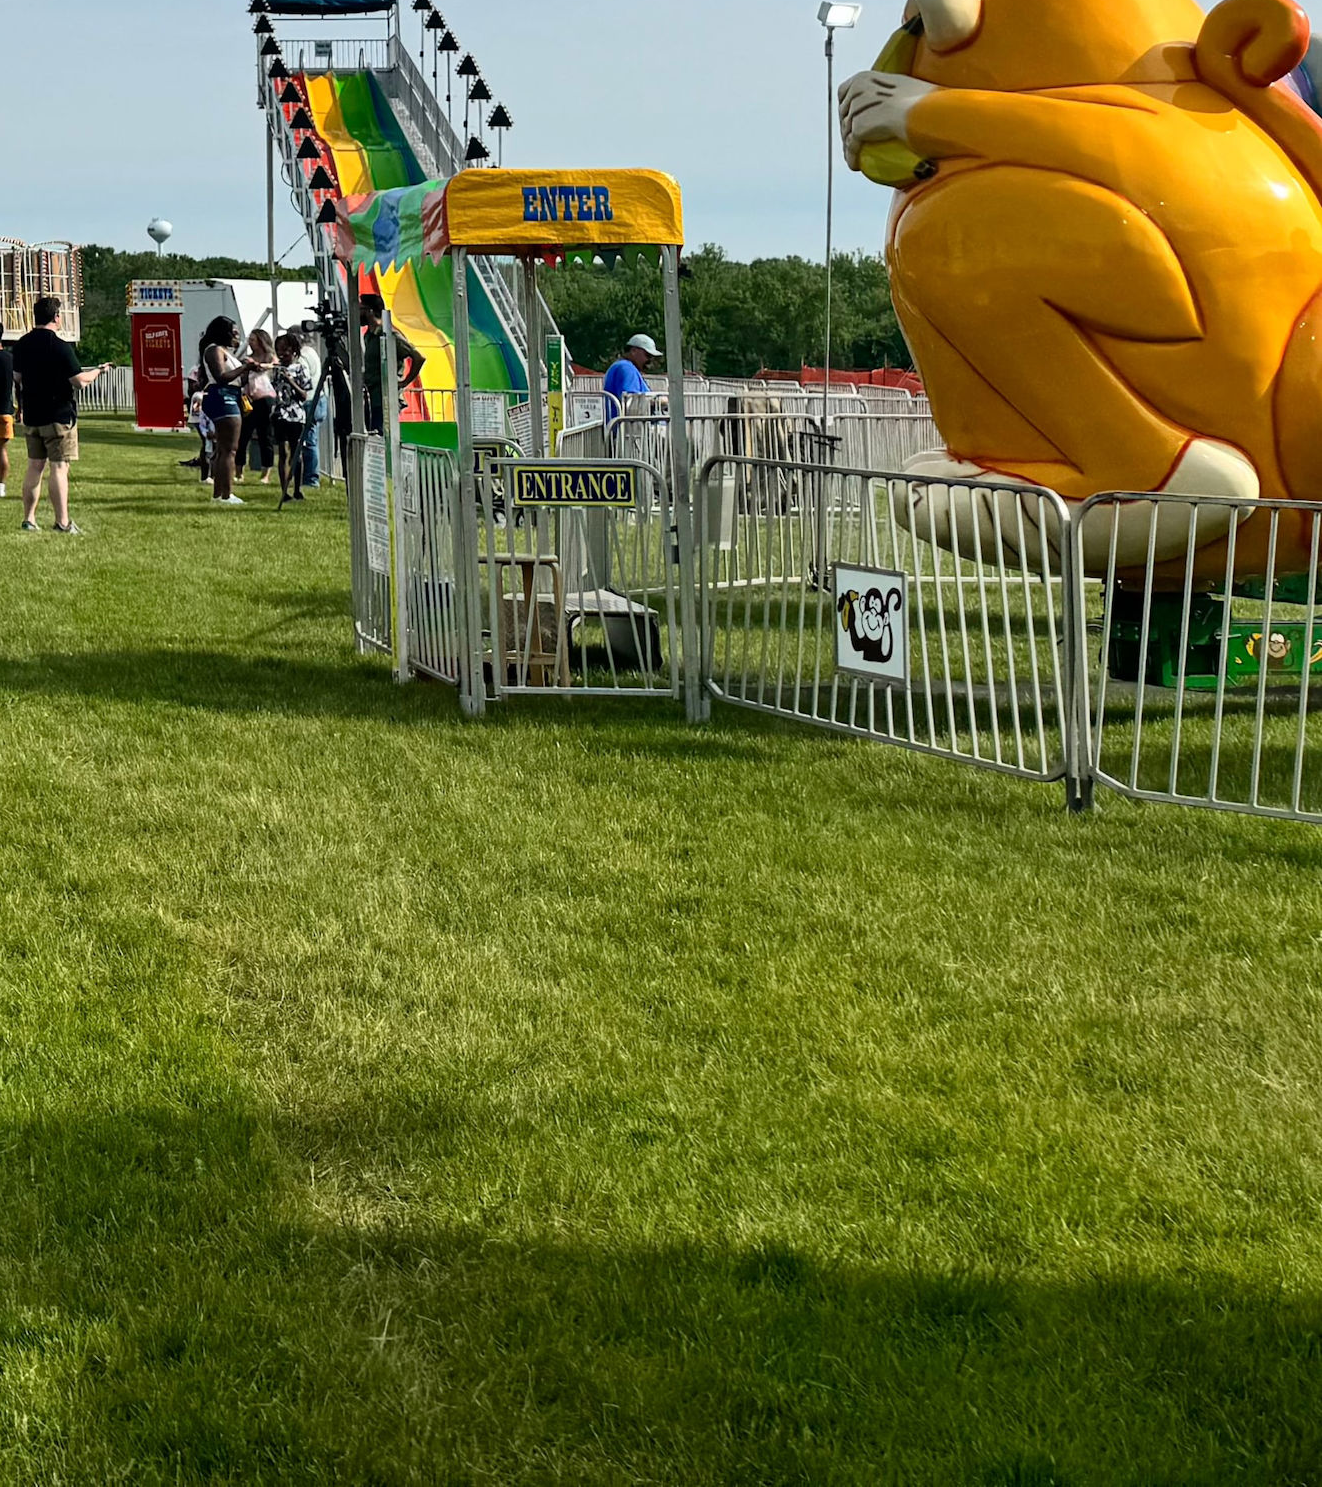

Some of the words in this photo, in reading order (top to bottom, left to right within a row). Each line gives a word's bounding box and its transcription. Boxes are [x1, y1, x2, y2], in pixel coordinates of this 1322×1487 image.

[522, 186, 613, 221] ENTER
[140, 288, 173, 300] TICKETS
[521, 472, 629, 500] ENTRANCE
